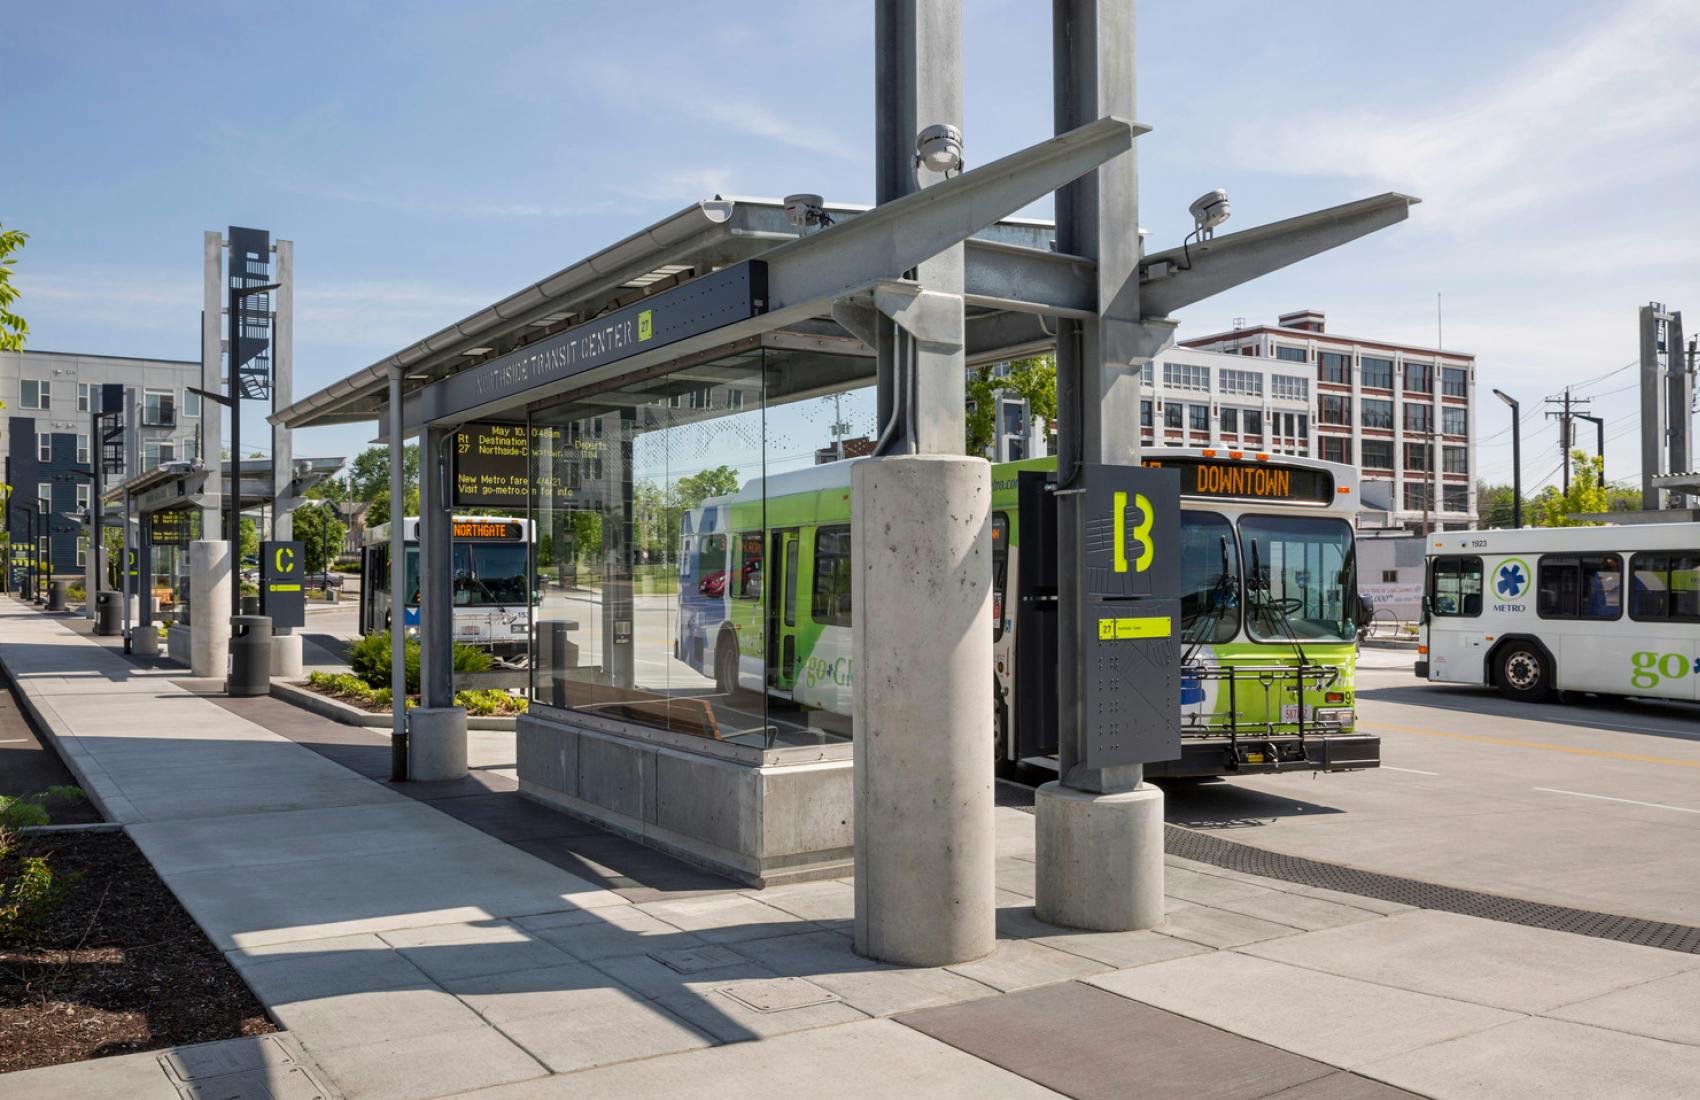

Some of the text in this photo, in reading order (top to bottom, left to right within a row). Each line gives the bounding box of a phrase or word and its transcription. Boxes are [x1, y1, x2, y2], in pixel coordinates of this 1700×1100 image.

[475, 320, 650, 395] NORTHSIDE TRANSIT CENTER 27
[491, 427, 510, 437] May
[458, 434, 469, 443] Rt
[479, 435, 527, 446] Destination
[458, 443, 470, 454] 27
[458, 474, 476, 483] New
[480, 475, 506, 484] Metro
[510, 475, 529, 485] fare
[1196, 463, 1289, 496] DOWNTOWN
[458, 485, 478, 494] Visit
[453, 524, 506, 537] NORTHGATE
[1113, 491, 1154, 573] B
[1472, 540, 1488, 548] 1923
[275, 548, 294, 573] C
[1492, 604, 1526, 612] METRO
[1103, 625, 1112, 634] 27
[1630, 651, 1690, 689] go
